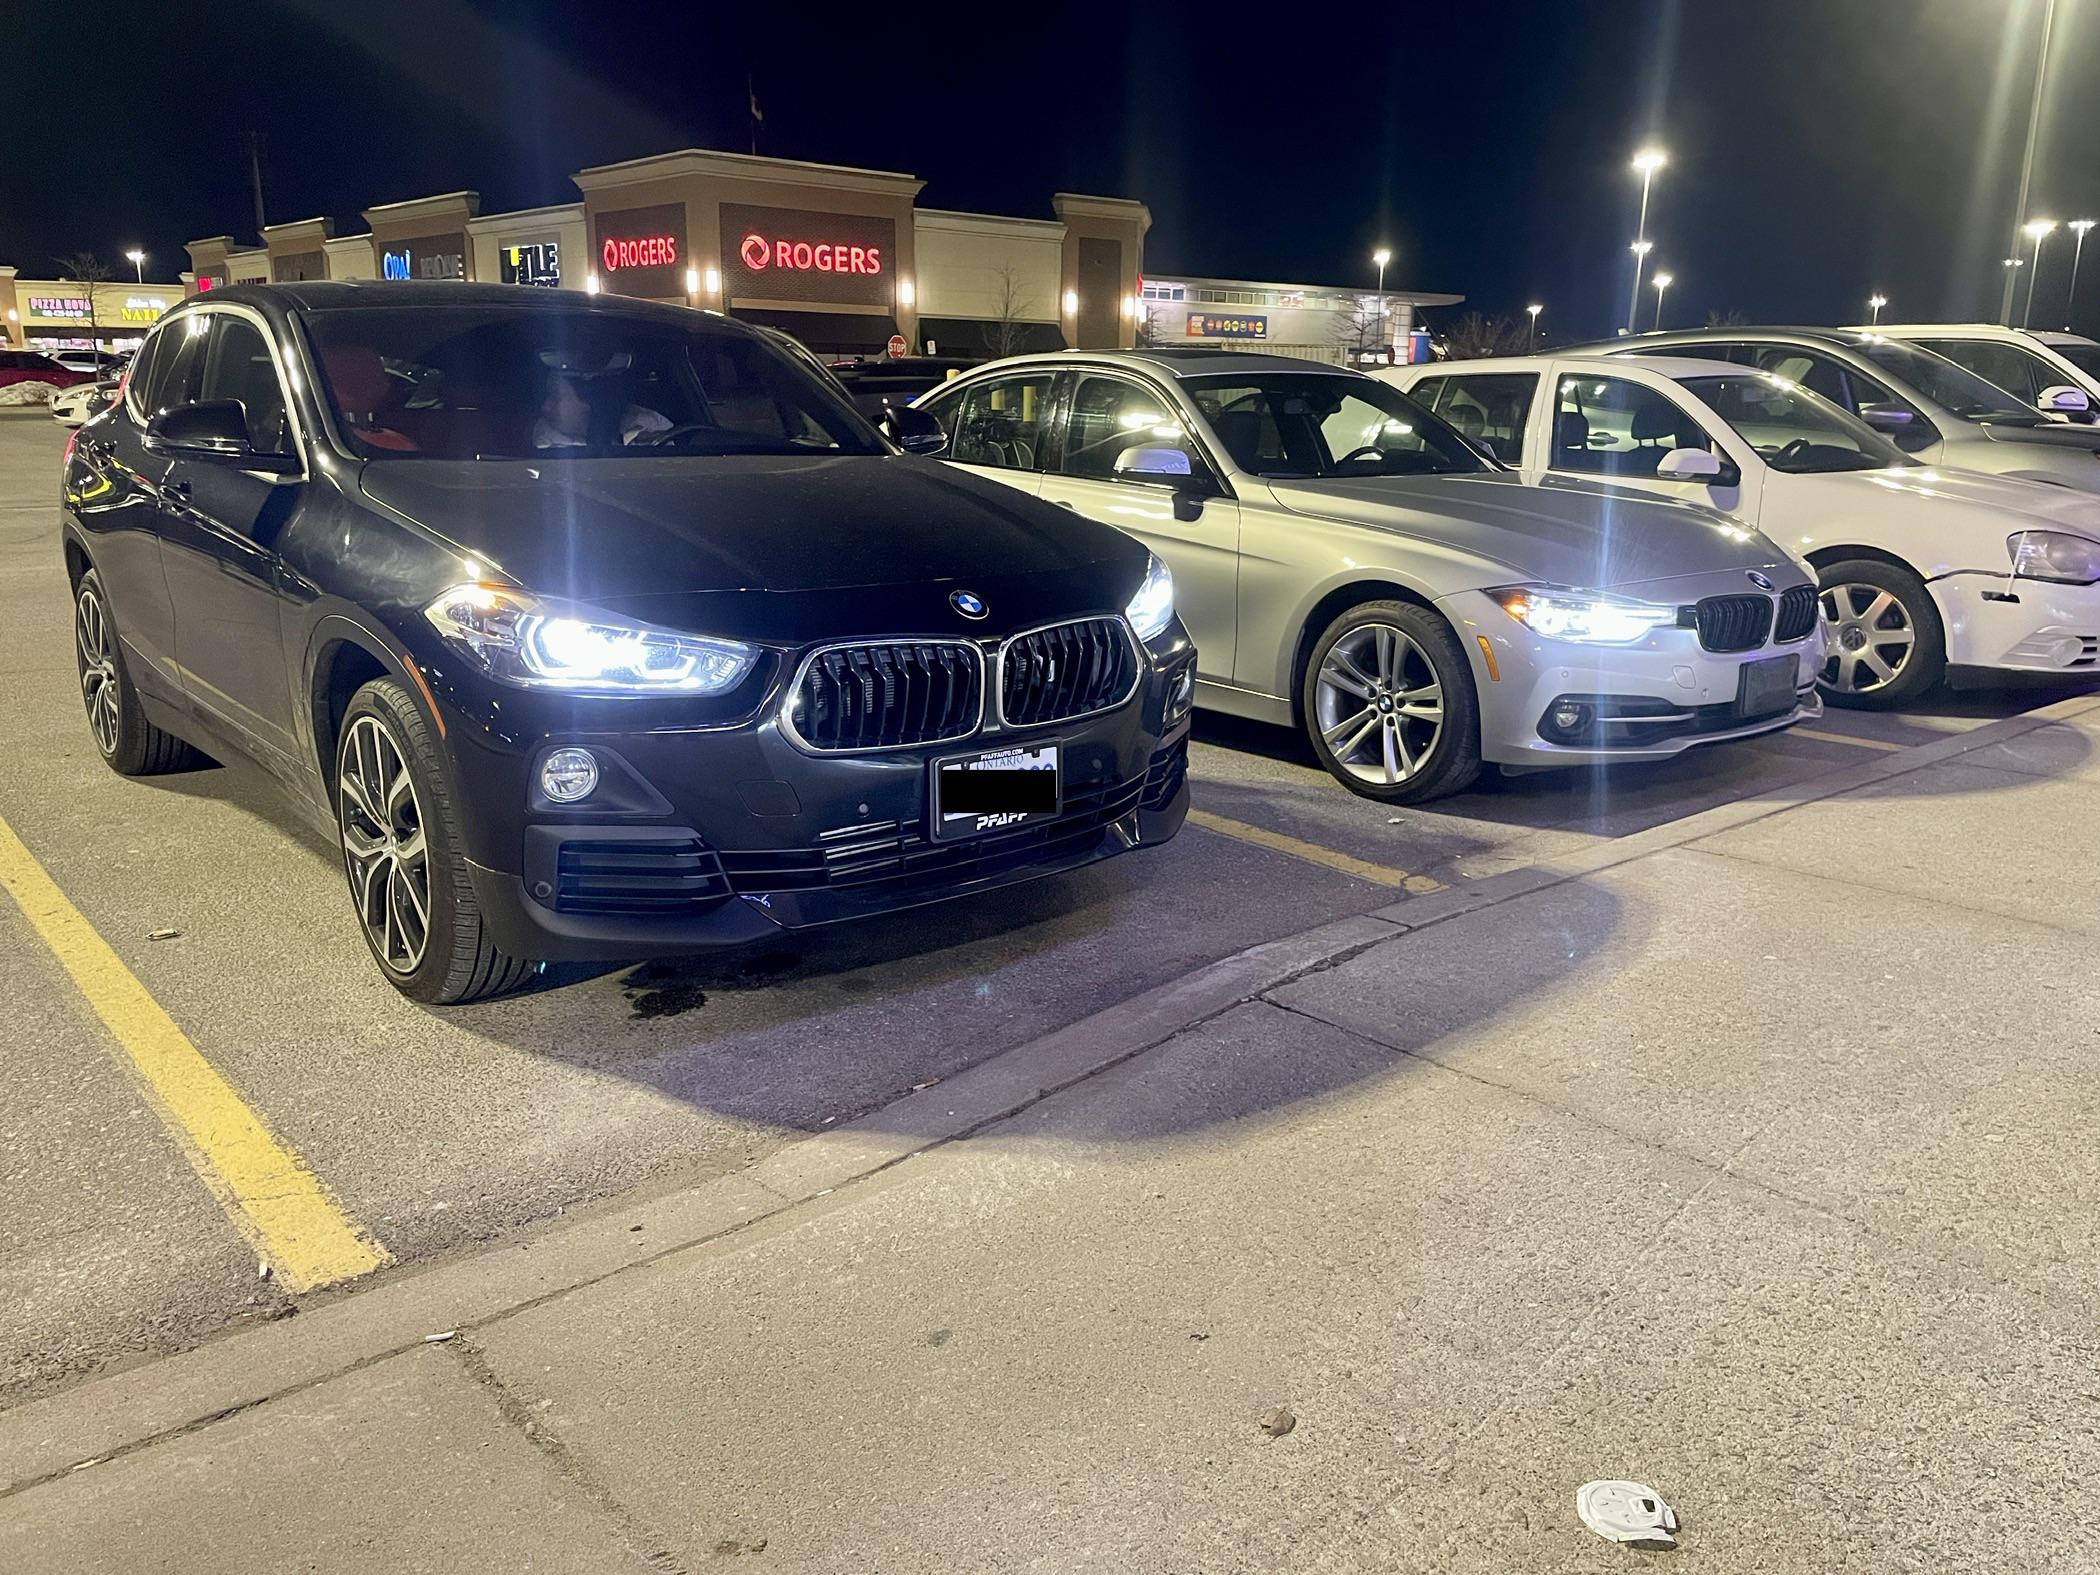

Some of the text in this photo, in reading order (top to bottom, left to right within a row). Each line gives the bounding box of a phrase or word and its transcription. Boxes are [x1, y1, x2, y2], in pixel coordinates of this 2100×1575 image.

[619, 237, 676, 268] ROGERS
[776, 240, 882, 275] ROGERS
[30, 298, 63, 310] PIZZA
[888, 343, 906, 353] STOP
[980, 747, 1024, 761] PFAFFAUTO.COM
[976, 754, 1024, 771] ONTARIO
